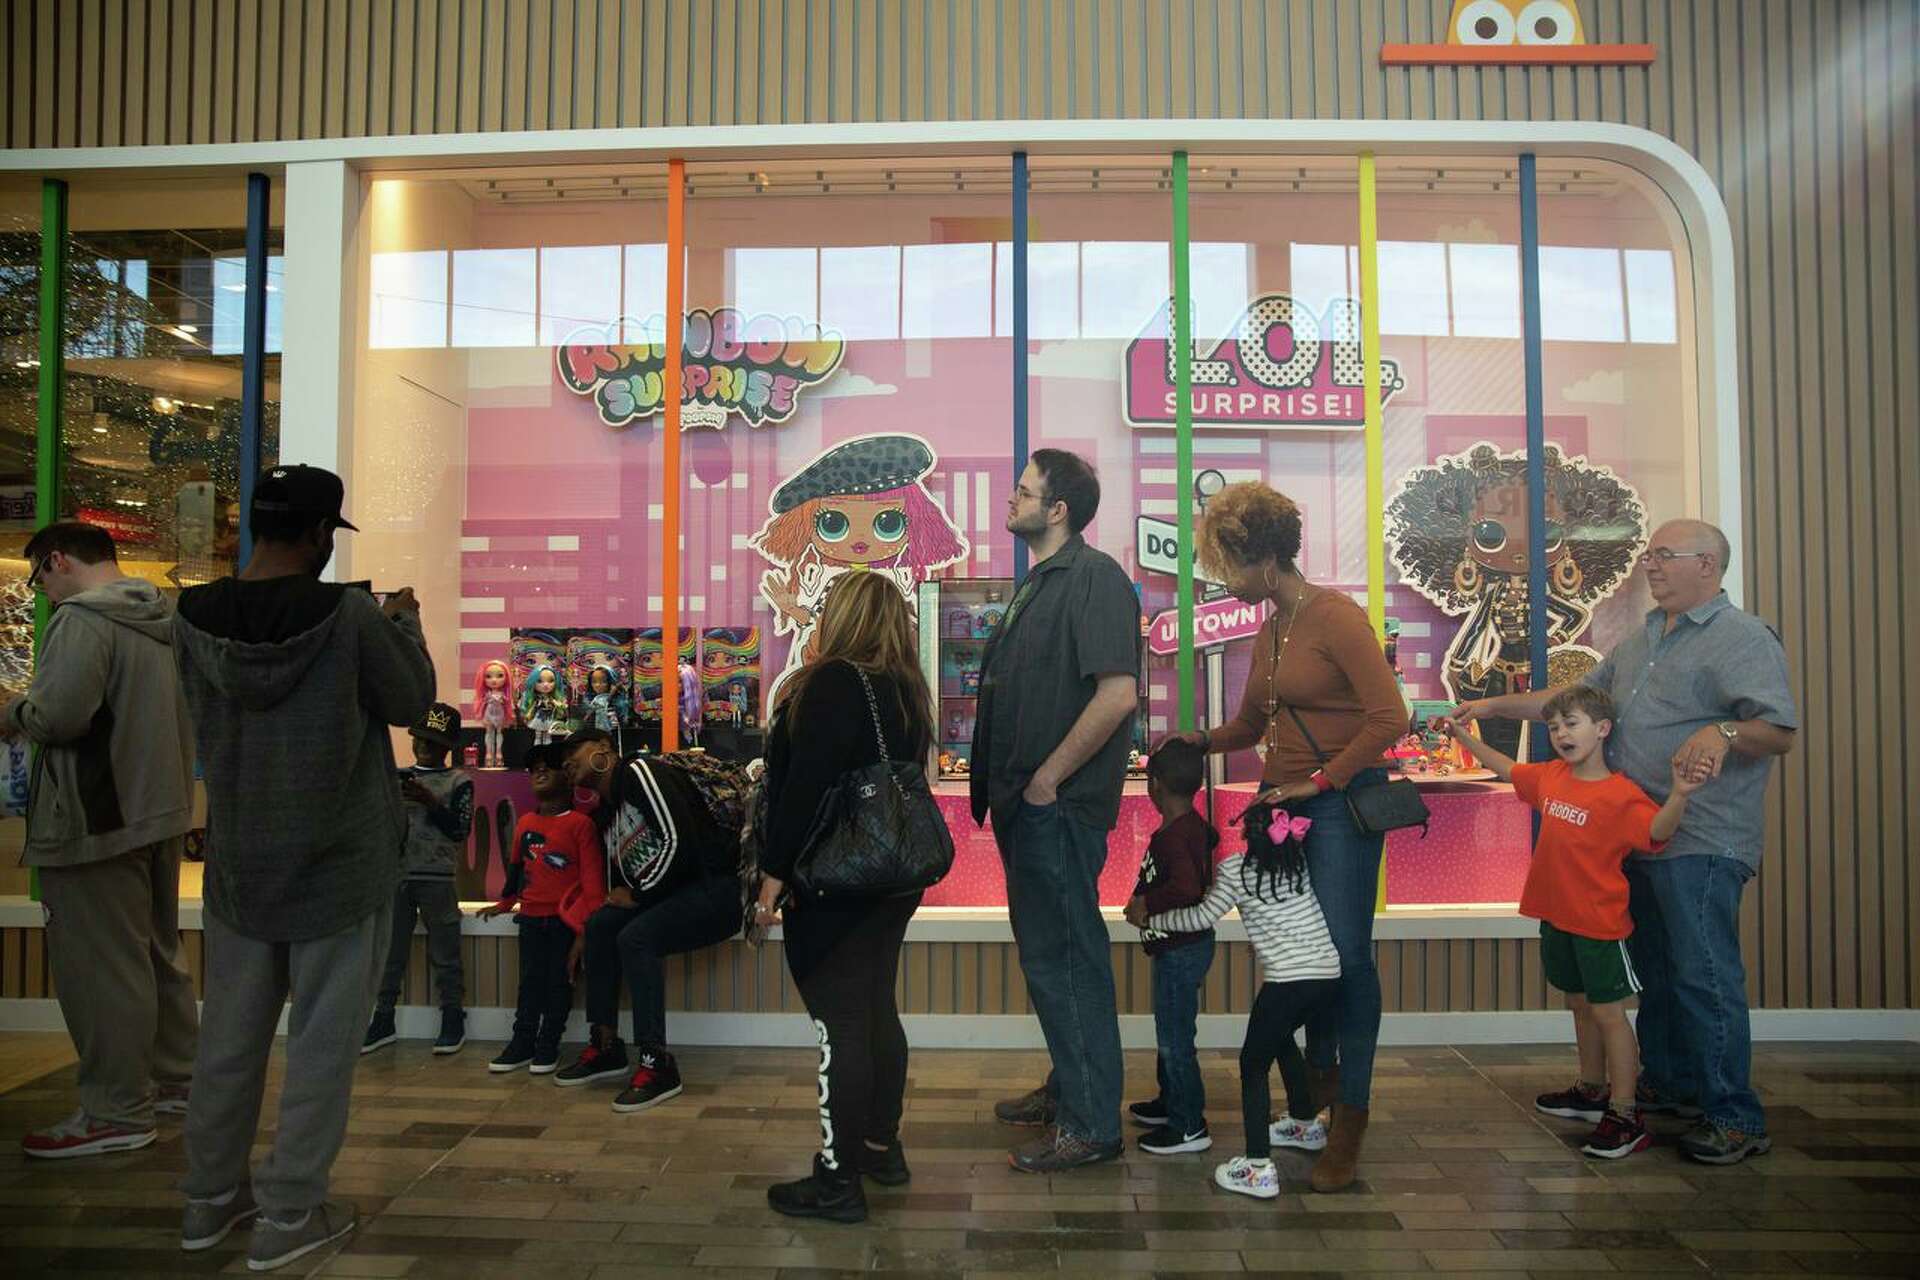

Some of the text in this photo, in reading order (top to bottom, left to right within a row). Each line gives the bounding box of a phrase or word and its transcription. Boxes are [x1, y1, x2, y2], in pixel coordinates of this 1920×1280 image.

[603, 364, 799, 417] SUPRISE
[1161, 604, 1257, 642] UTOWN
[1549, 803, 1587, 826] RODEO
